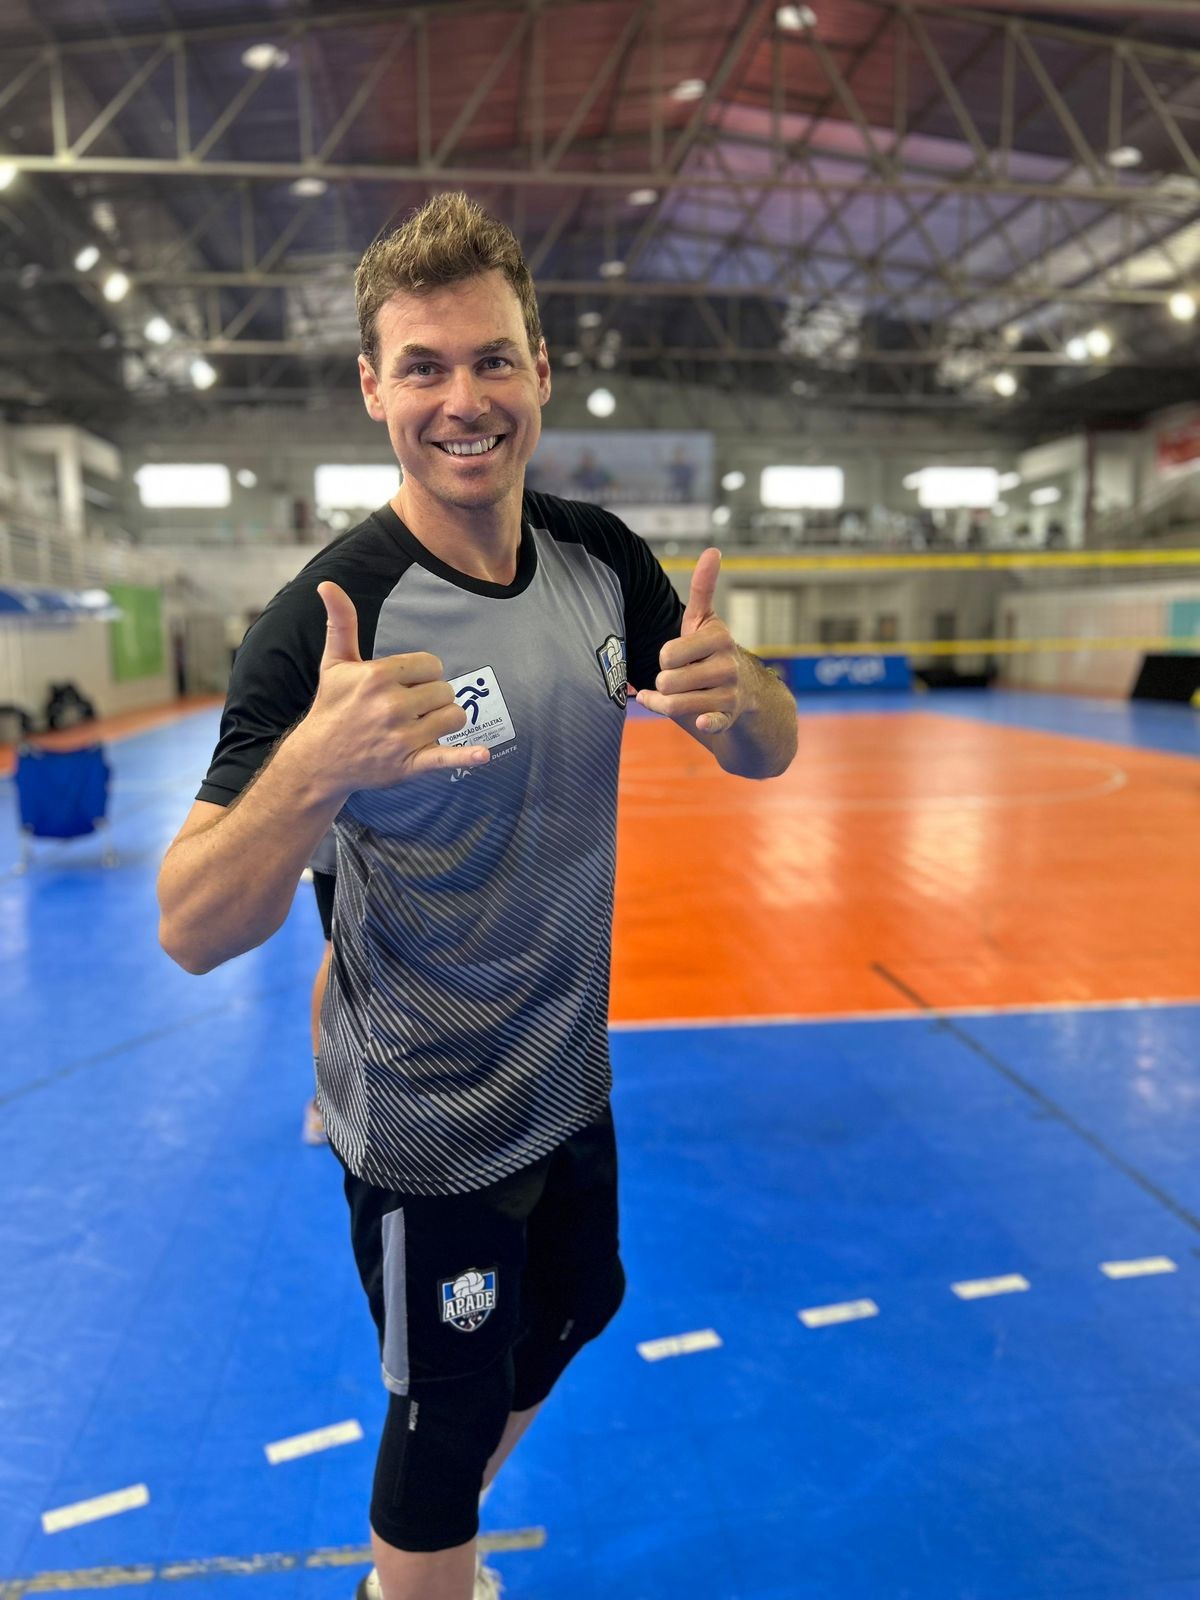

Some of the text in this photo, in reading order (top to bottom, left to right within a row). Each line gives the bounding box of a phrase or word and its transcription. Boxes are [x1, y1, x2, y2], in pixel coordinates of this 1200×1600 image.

[446, 728, 475, 742] FORMAÇÃO
[482, 717, 503, 728] ATLETAS
[491, 745, 518, 760] DUARTE
